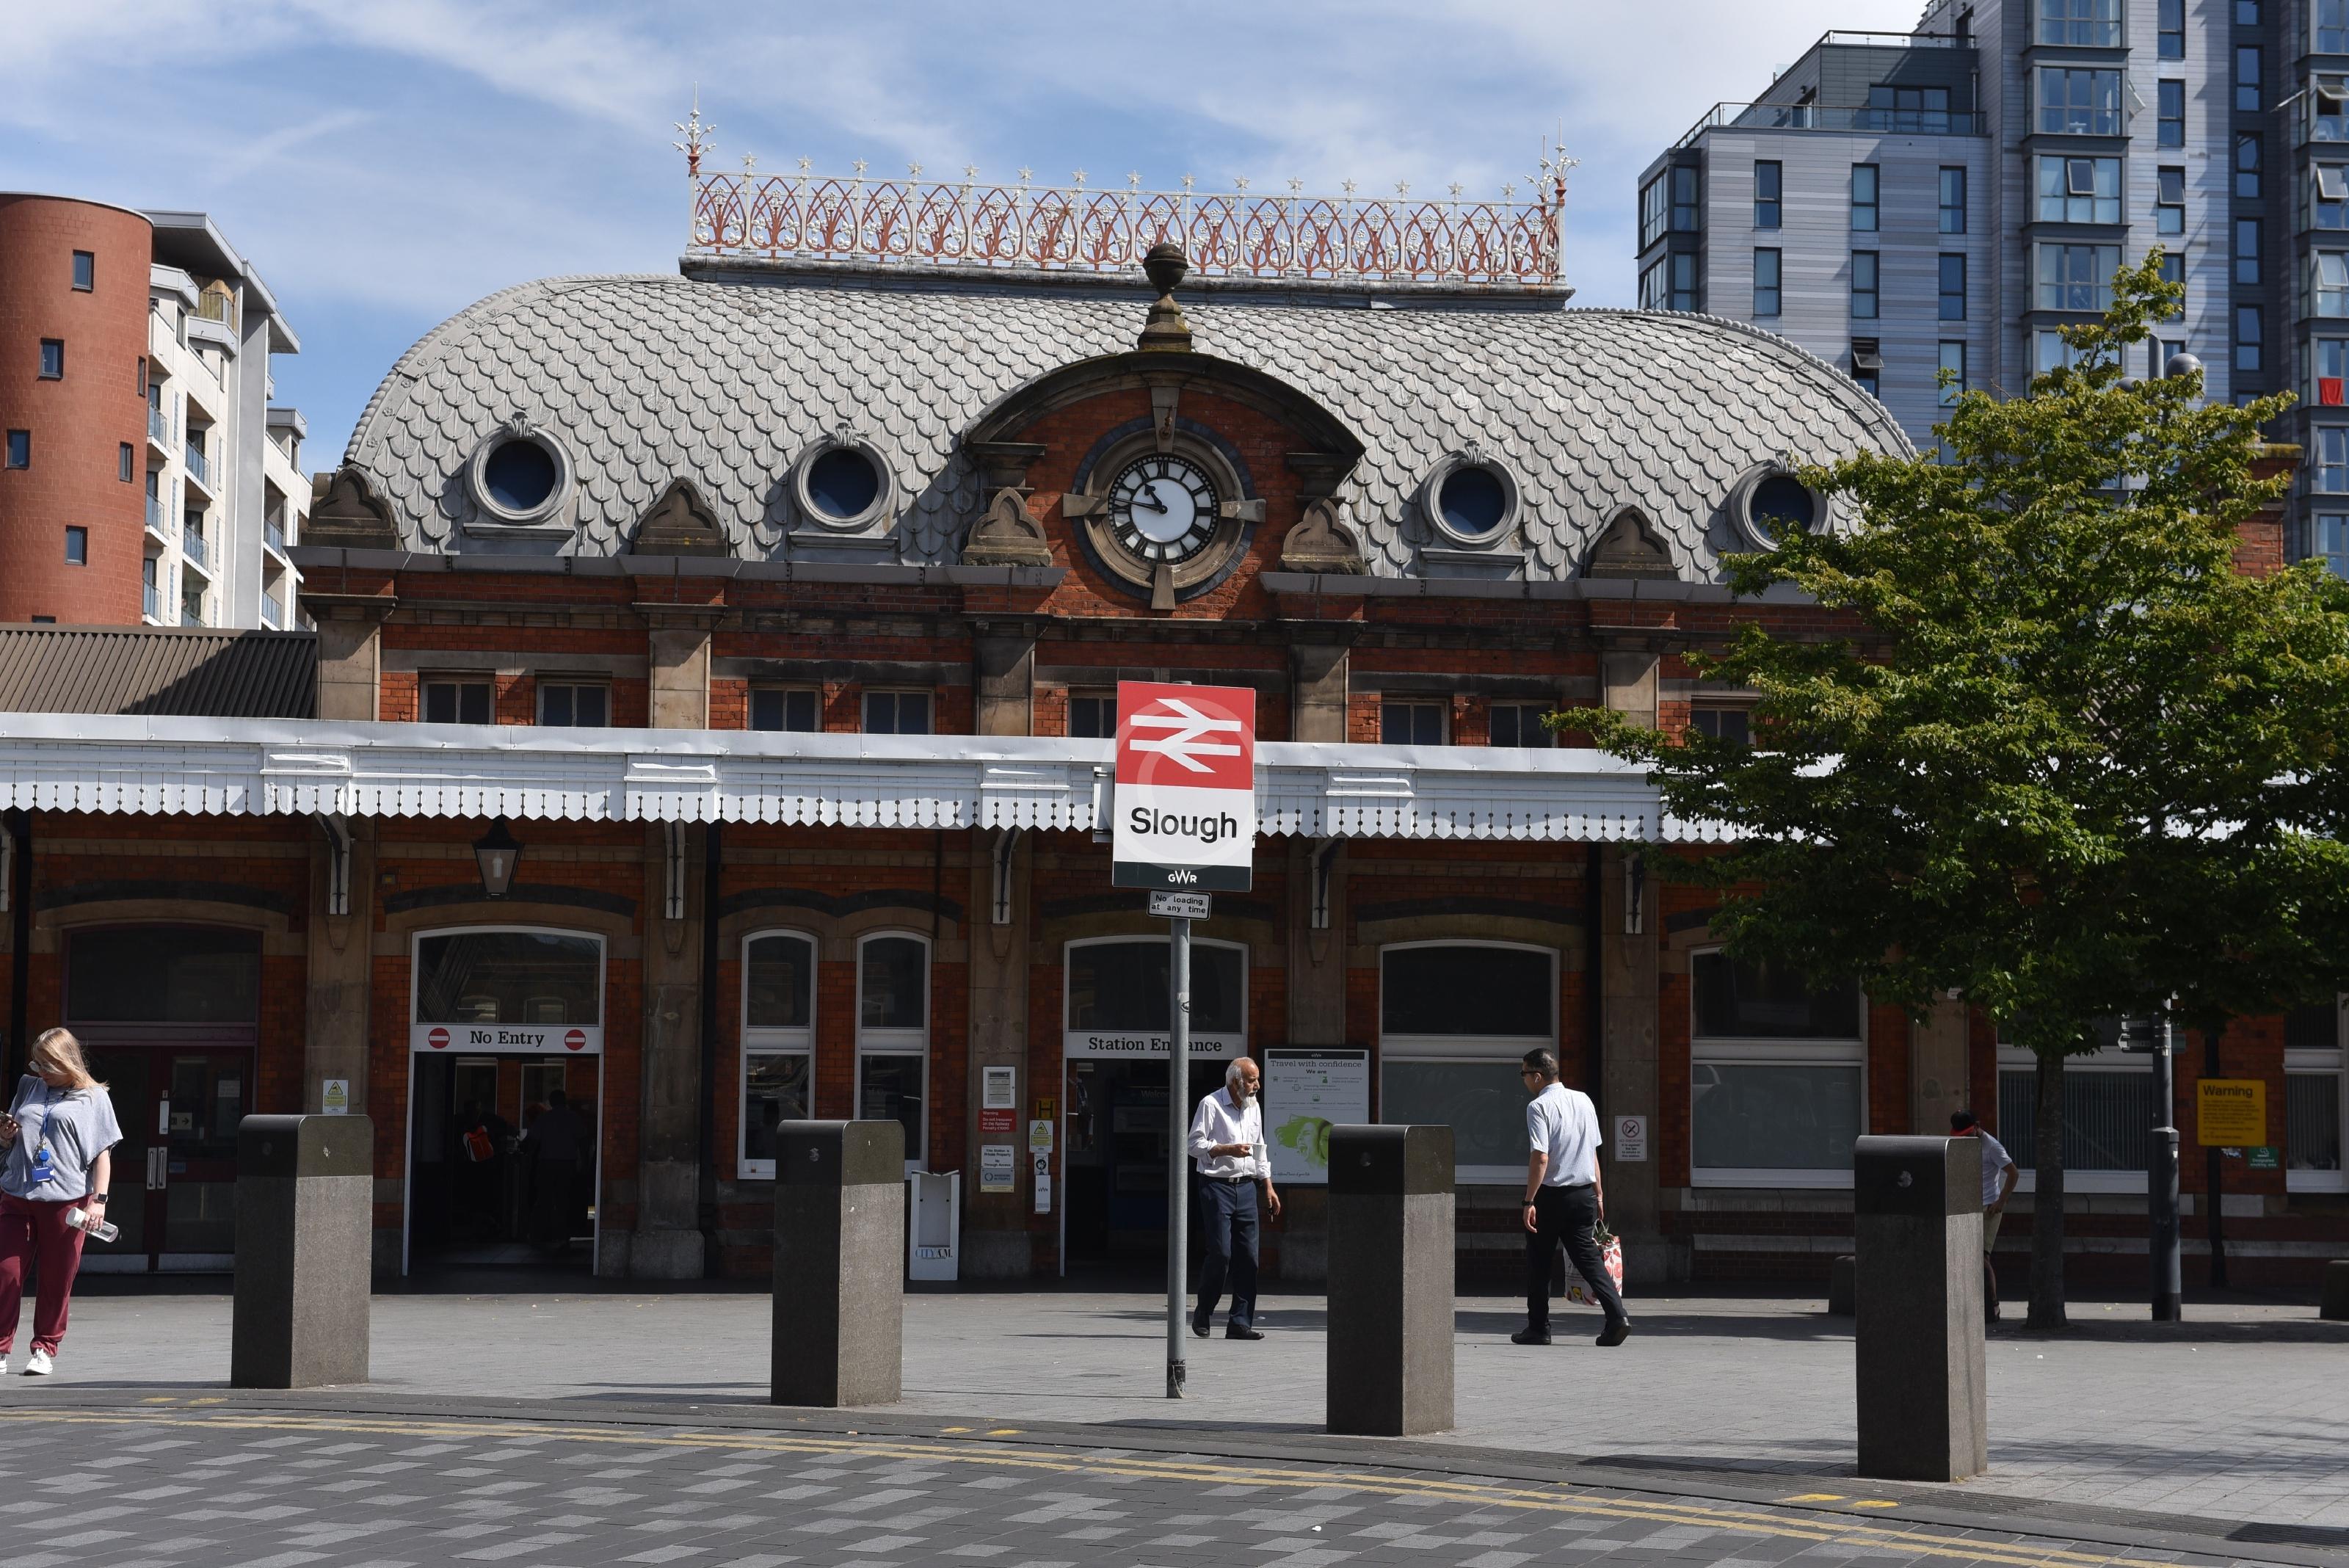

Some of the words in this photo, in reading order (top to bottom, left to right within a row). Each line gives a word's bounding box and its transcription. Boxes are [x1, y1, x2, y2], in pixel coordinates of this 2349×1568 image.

[1130, 807, 1237, 843] Slough
[1168, 869, 1197, 885] GWR
[1155, 894, 1167, 902] No
[1173, 896, 1203, 906] loading
[1166, 905, 1182, 913] any
[1188, 905, 1206, 914] time
[470, 1031, 493, 1044] No
[498, 1031, 545, 1048] Entry
[1089, 1037, 1145, 1050] Station
[1150, 1037, 1223, 1051] Enance
[2203, 1085, 2253, 1098] Warning
